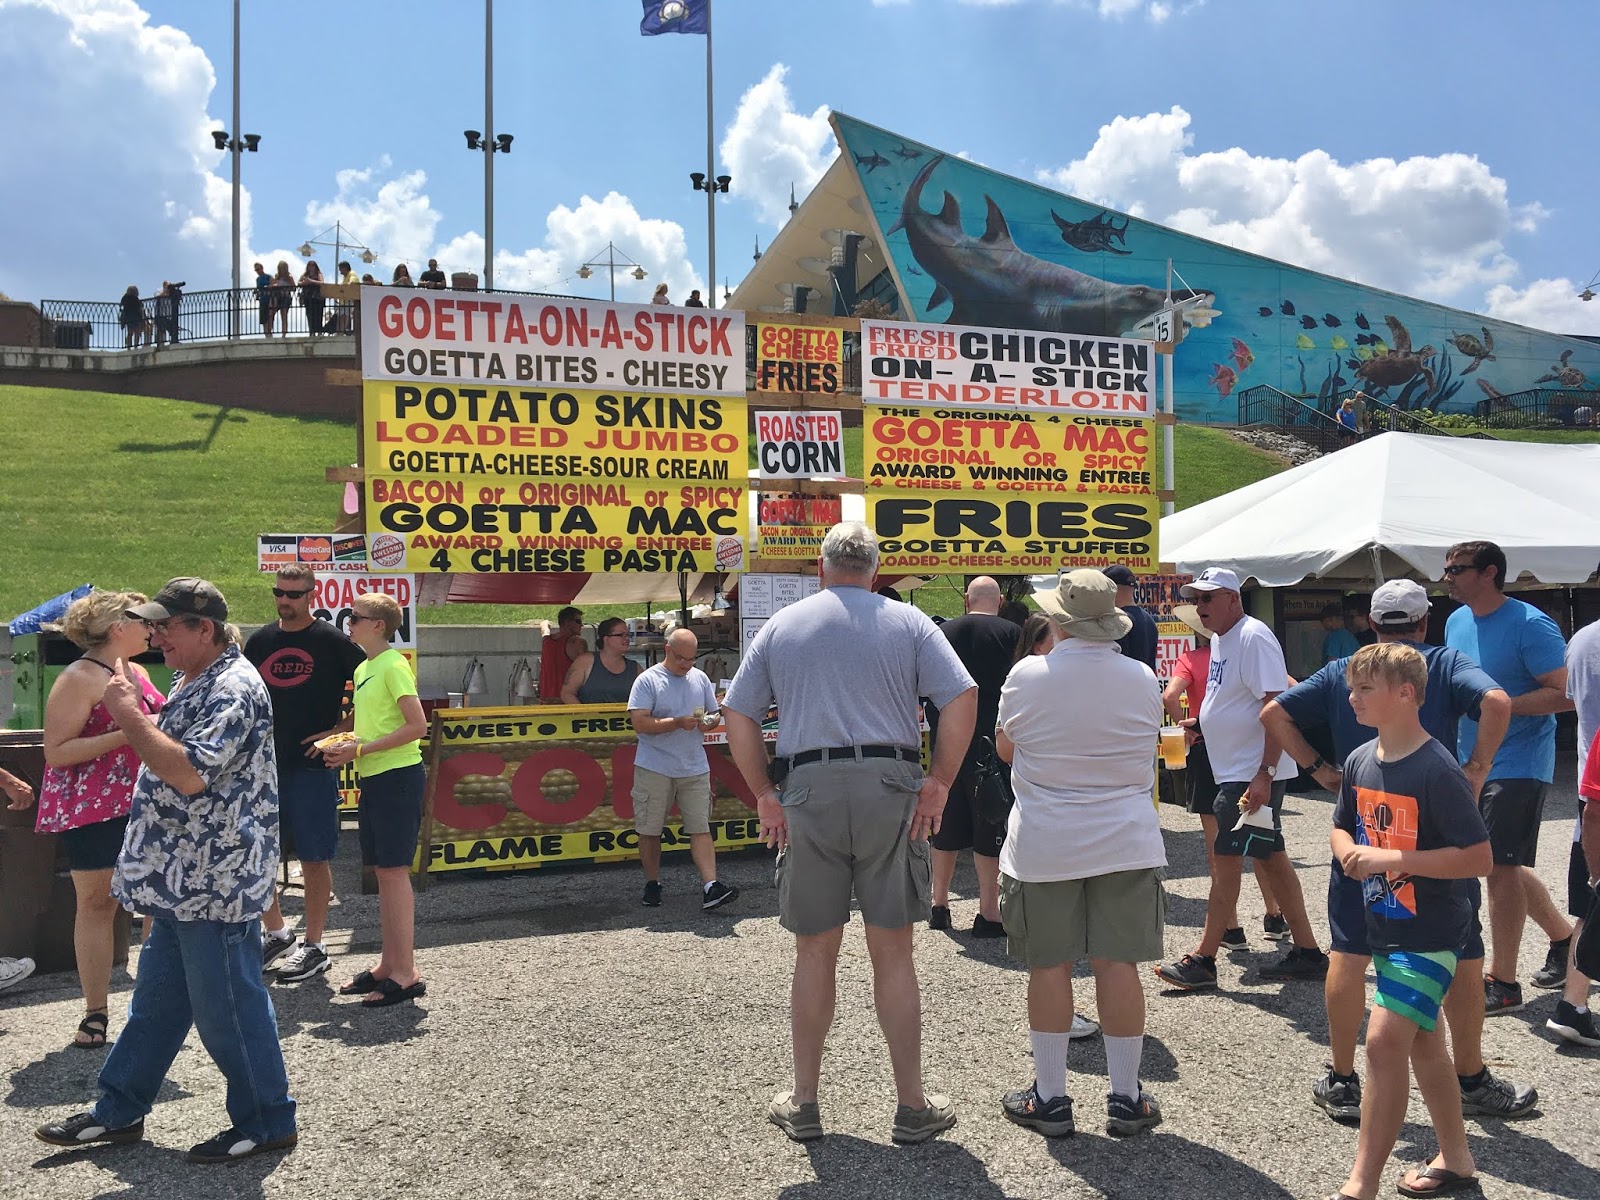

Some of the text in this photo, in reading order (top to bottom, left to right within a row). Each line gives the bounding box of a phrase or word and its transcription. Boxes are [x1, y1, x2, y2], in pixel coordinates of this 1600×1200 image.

[377, 294, 733, 357] GOETTA-ON-A-STICK
[761, 326, 839, 347] GOETTA
[1158, 321, 1168, 342] 15
[868, 326, 956, 348] FRESH
[761, 342, 838, 362] CHEESE
[869, 341, 958, 360] FRIED
[959, 331, 1149, 371] CHICKEN
[384, 347, 504, 379] GOETTA
[516, 354, 598, 384] BITES
[623, 359, 728, 390] CHEESY
[762, 360, 838, 393] FRIES
[871, 357, 953, 380] ON-
[1032, 366, 1148, 393] STICK
[869, 380, 1147, 412] TENDERLOIN
[394, 386, 723, 430] POTATO SKINS
[878, 407, 1143, 428] THE ORIGINAL 4 CHEESE
[376, 421, 740, 453] LOADED JUMBO
[759, 415, 839, 442] ROASTED
[872, 417, 1149, 454] GOETTA MAC
[389, 450, 729, 480] GOETTA-CHEESE-SOUR CREAM
[761, 441, 841, 474] CORN
[876, 446, 1147, 470] ORIGINAL OR SPICY
[870, 462, 1151, 485] AWARD WINNING ENTREE
[372, 479, 743, 509] BACON or ORIGINAL or SPICY
[870, 478, 1151, 495] 4 CHEESE & GOETTA & PASTA
[380, 503, 738, 536] GOETTA MAC
[761, 501, 840, 523] GOETTA MAC
[875, 499, 1152, 540] FRIES
[411, 534, 503, 550] AWARD
[517, 535, 632, 550] WINNING
[636, 536, 712, 551] ENTREE
[760, 527, 779, 537] BACON
[789, 527, 815, 537] ORIGINAL
[763, 537, 796, 545] AWARD
[269, 545, 286, 553] VISA
[299, 546, 331, 554] MasterCard
[373, 543, 403, 559] AWESOME
[766, 547, 787, 556] CHEESE
[793, 547, 816, 556] GOETTA
[878, 540, 1150, 555] GOETTA STUFFED
[339, 563, 368, 571] CASH
[430, 549, 452, 572] 4
[471, 549, 586, 572] CHEESE
[603, 550, 698, 573] PASTA
[878, 555, 1151, 568] LOADED-CHEESE-SOUR CREAM-CHILI
[1133, 583, 1166, 604] GOETTA
[1156, 639, 1191, 659] ETTA
[272, 662, 314, 674] REDS
[572, 717, 633, 733] FRES
[428, 835, 563, 866] FLAME
